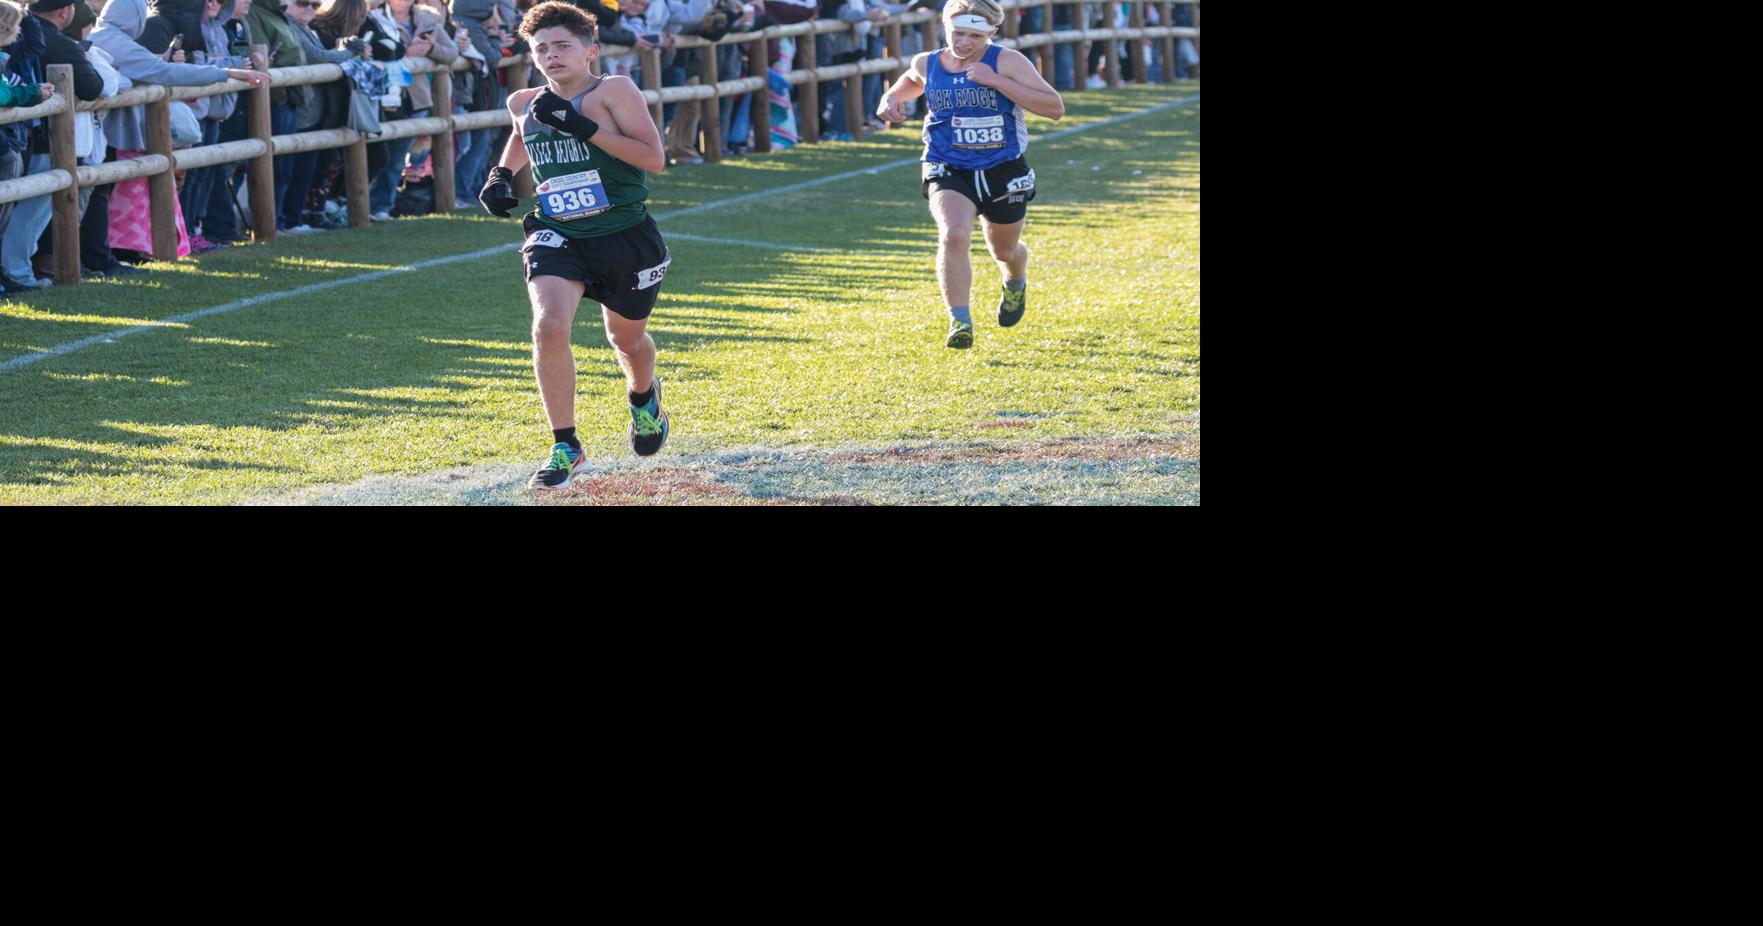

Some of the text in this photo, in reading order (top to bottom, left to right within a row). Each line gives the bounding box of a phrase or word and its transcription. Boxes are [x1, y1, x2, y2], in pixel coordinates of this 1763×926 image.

[930, 87, 998, 113] OAK RIDGE
[954, 127, 1003, 143] 1038
[548, 188, 596, 213] 936
[533, 232, 554, 242] 36
[649, 266, 666, 281] 93
